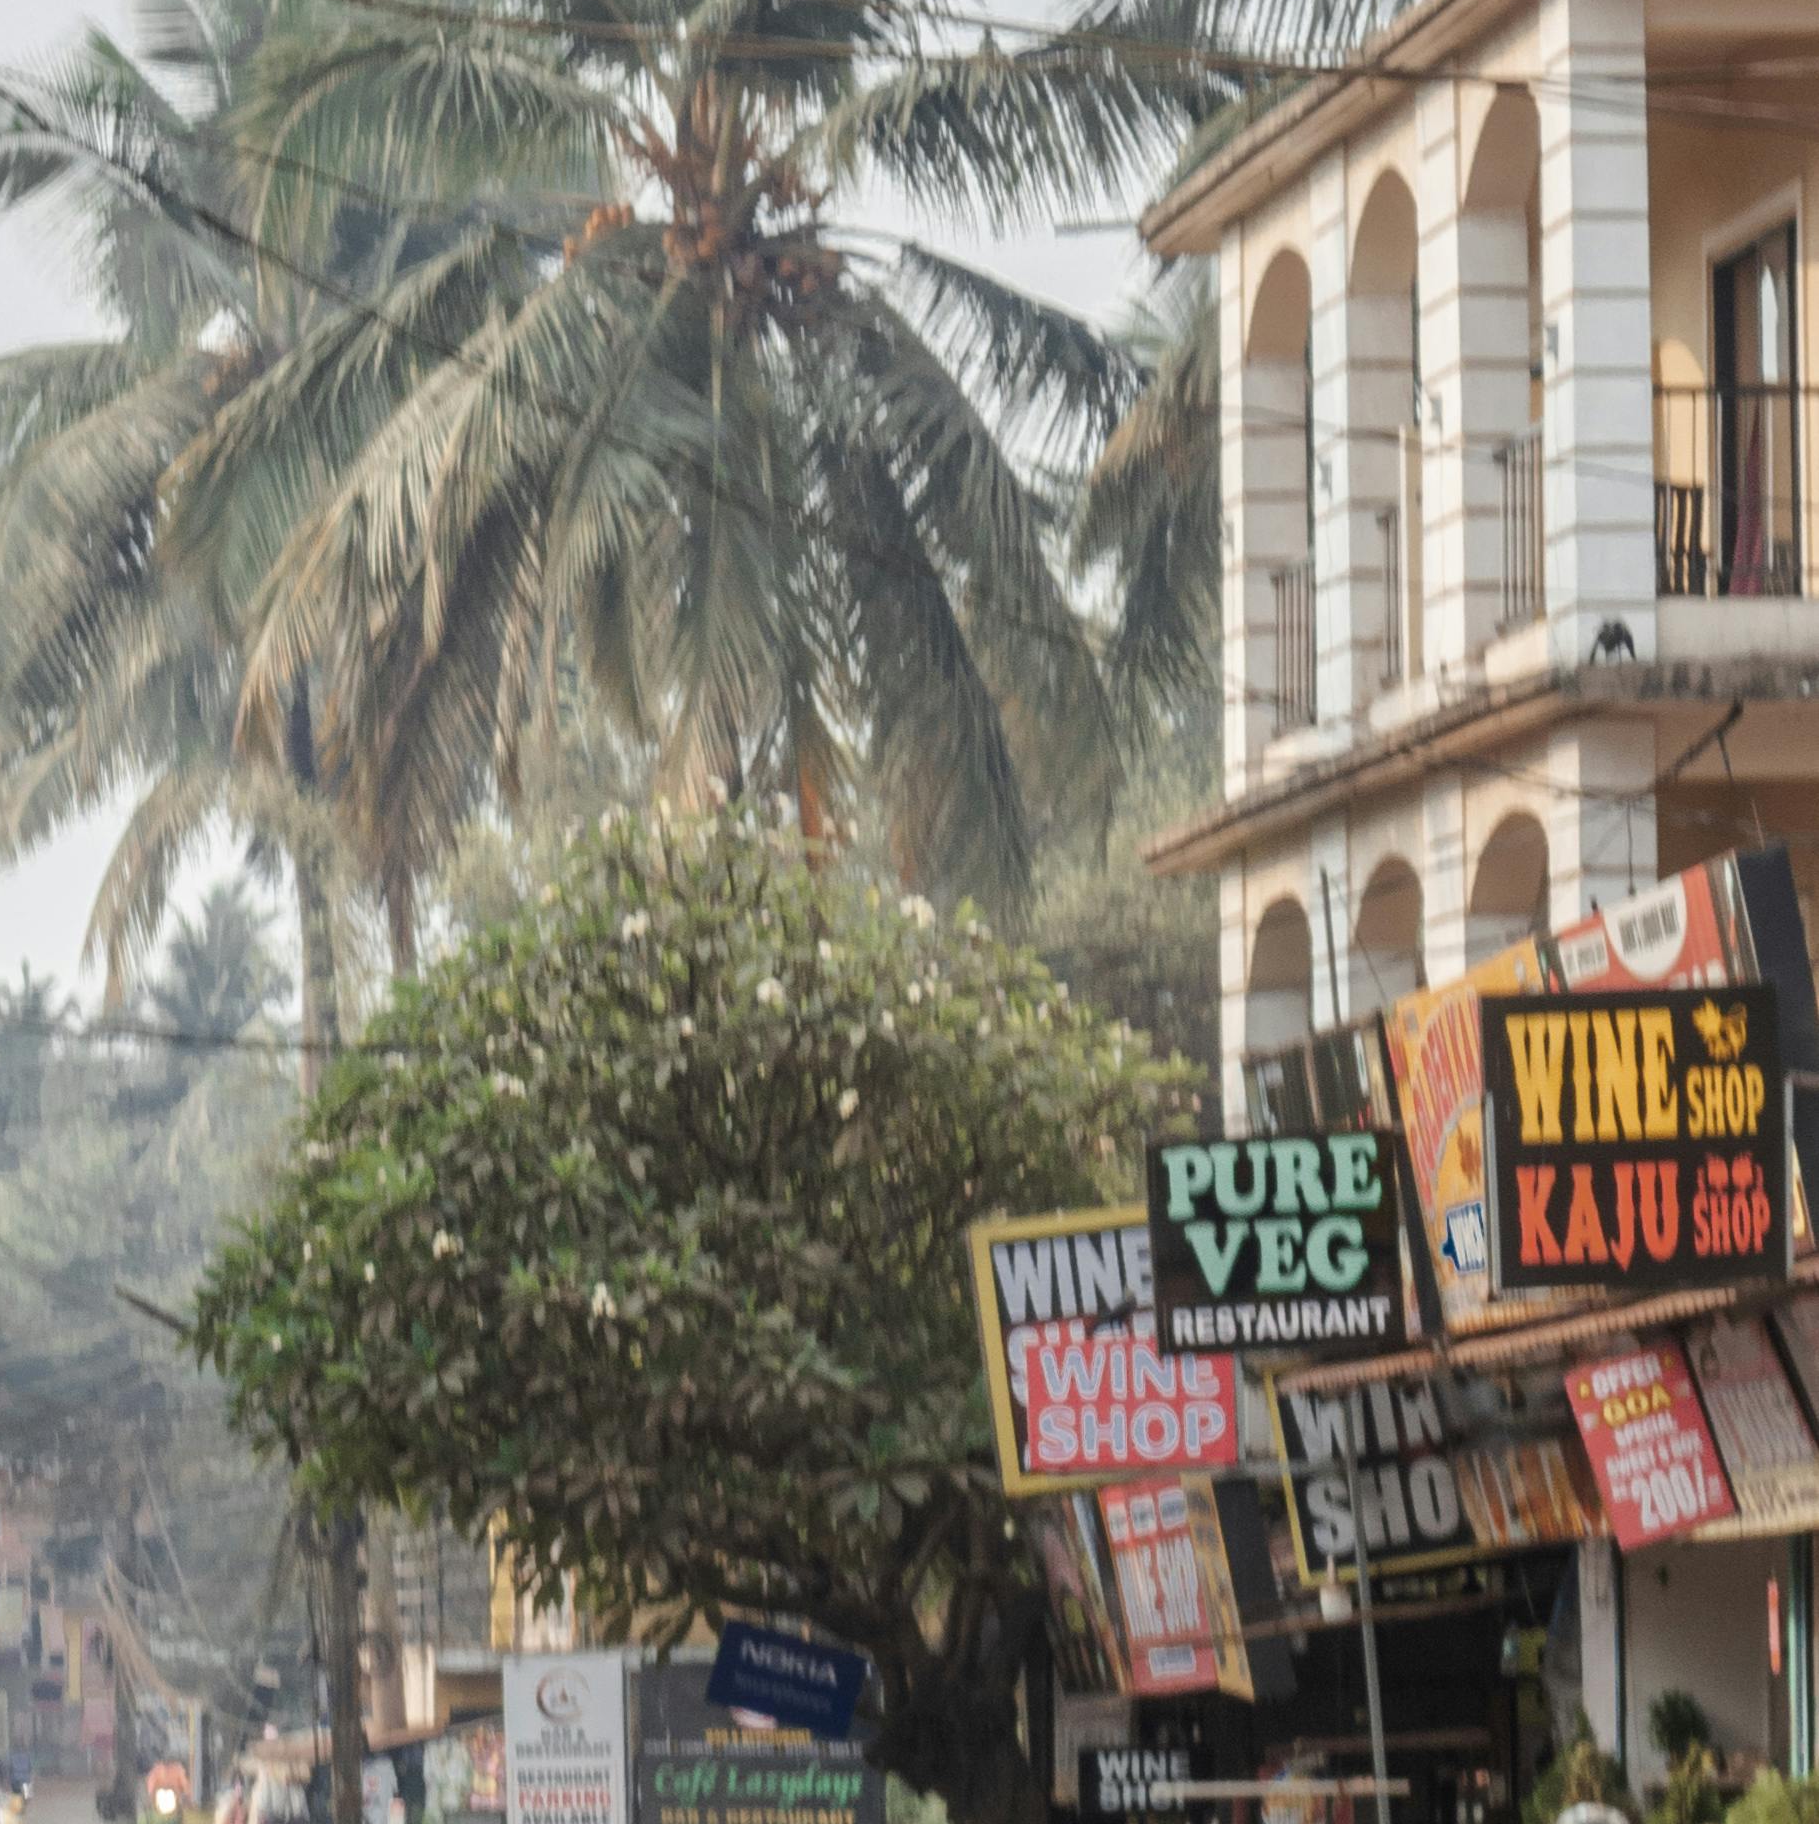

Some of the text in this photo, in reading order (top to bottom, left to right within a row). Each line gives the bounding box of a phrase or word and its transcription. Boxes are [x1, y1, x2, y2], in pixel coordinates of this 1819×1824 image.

[1506, 1005, 1766, 1145] WINE SHOP
[1161, 1132, 1383, 1223] PURE
[1515, 1159, 1680, 1273] KAJU
[1693, 1186, 1772, 1258] SHOP
[992, 1226, 1156, 1323] WINE
[1183, 1214, 1370, 1297] VEG
[1172, 1295, 1391, 1347] RESTAURANT
[1039, 1341, 1221, 1402] WINE
[1038, 1401, 1226, 1464] SHOP
[1289, 1378, 1444, 1466] WIN
[1602, 1383, 1671, 1426] GOA
[1306, 1457, 1460, 1555] SHO
[741, 1639, 838, 1687] NOKIA
[1097, 1750, 1190, 1783] WINE
[1099, 1778, 1186, 1812] SHO
[518, 1789, 611, 1809] PARKING
